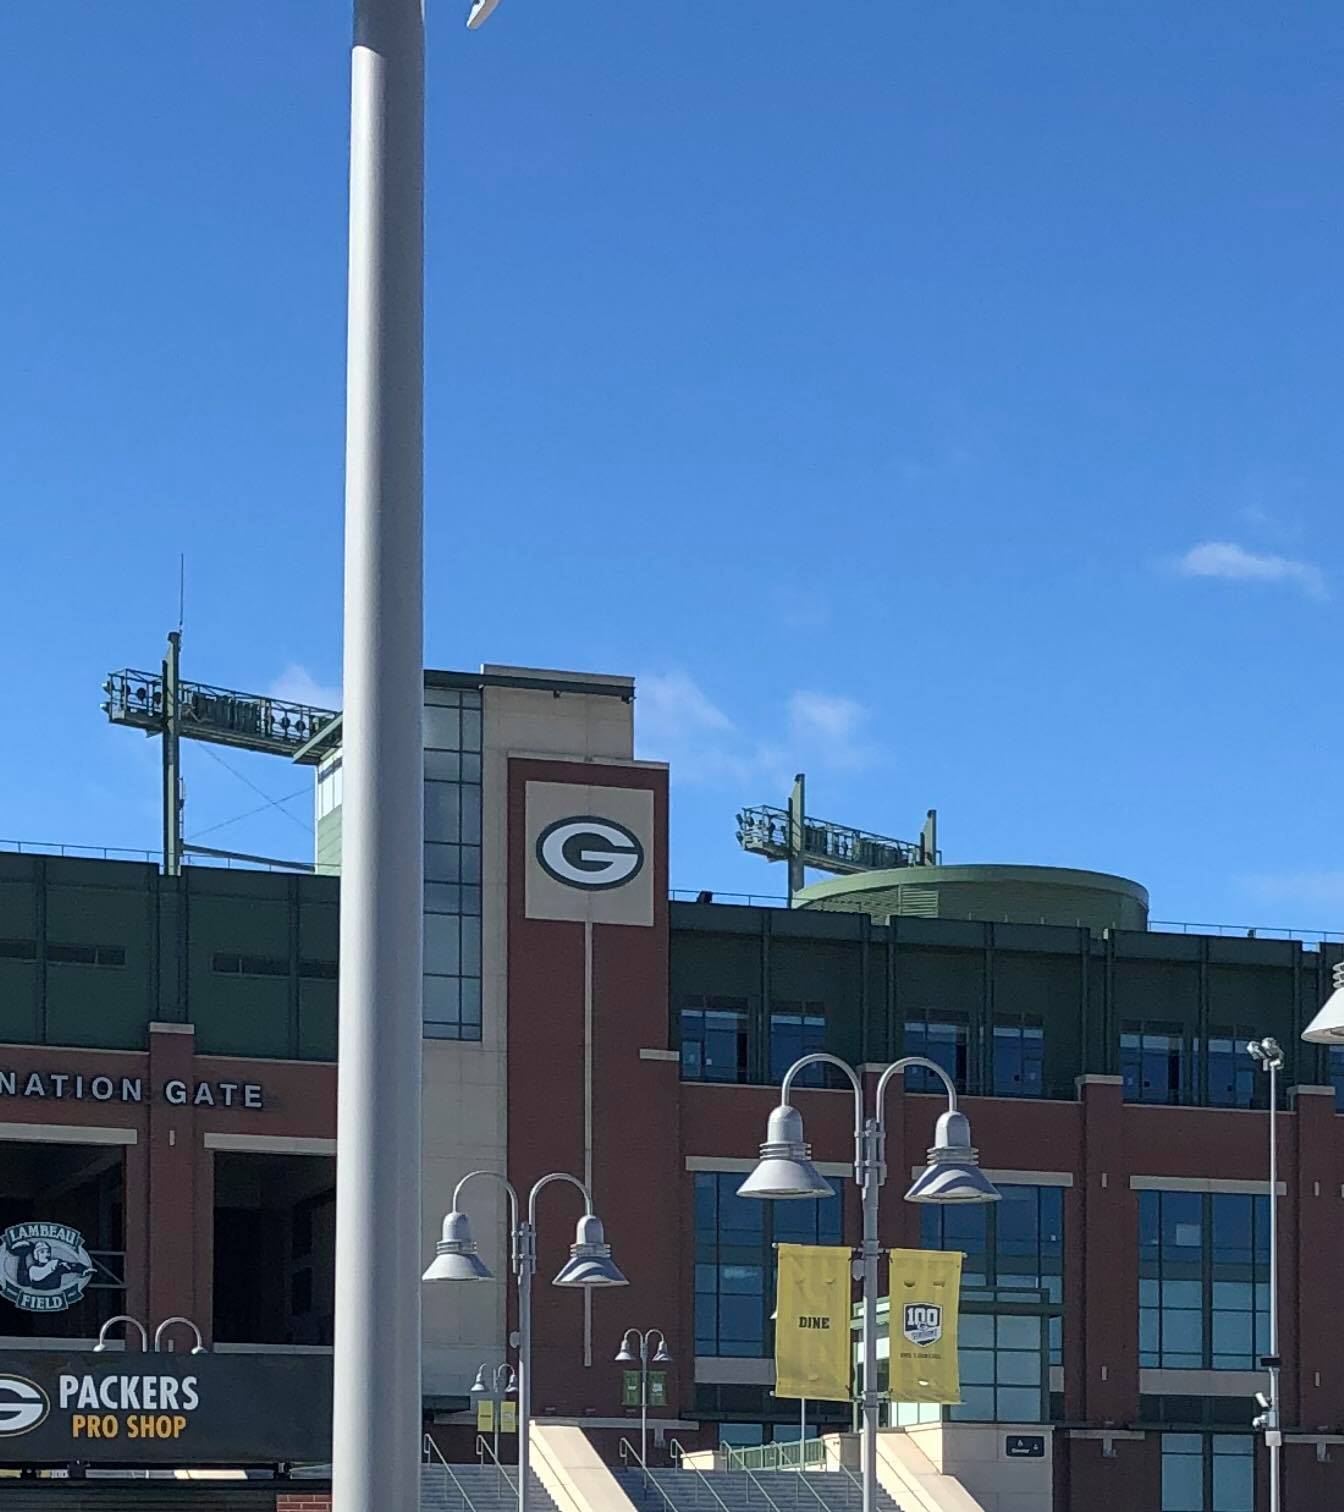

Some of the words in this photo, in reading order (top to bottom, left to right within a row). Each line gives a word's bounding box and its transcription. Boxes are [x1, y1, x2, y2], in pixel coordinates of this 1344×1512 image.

[165, 1080, 263, 1109] GATE
[9, 1224, 77, 1245] LAMBEAU
[20, 1295, 63, 1310] FIELD
[799, 1316, 830, 1329] DINE
[907, 1307, 939, 1327] 100
[59, 1374, 199, 1410] PACKERS
[72, 1414, 119, 1439] PRO
[127, 1415, 187, 1439] SHOP
